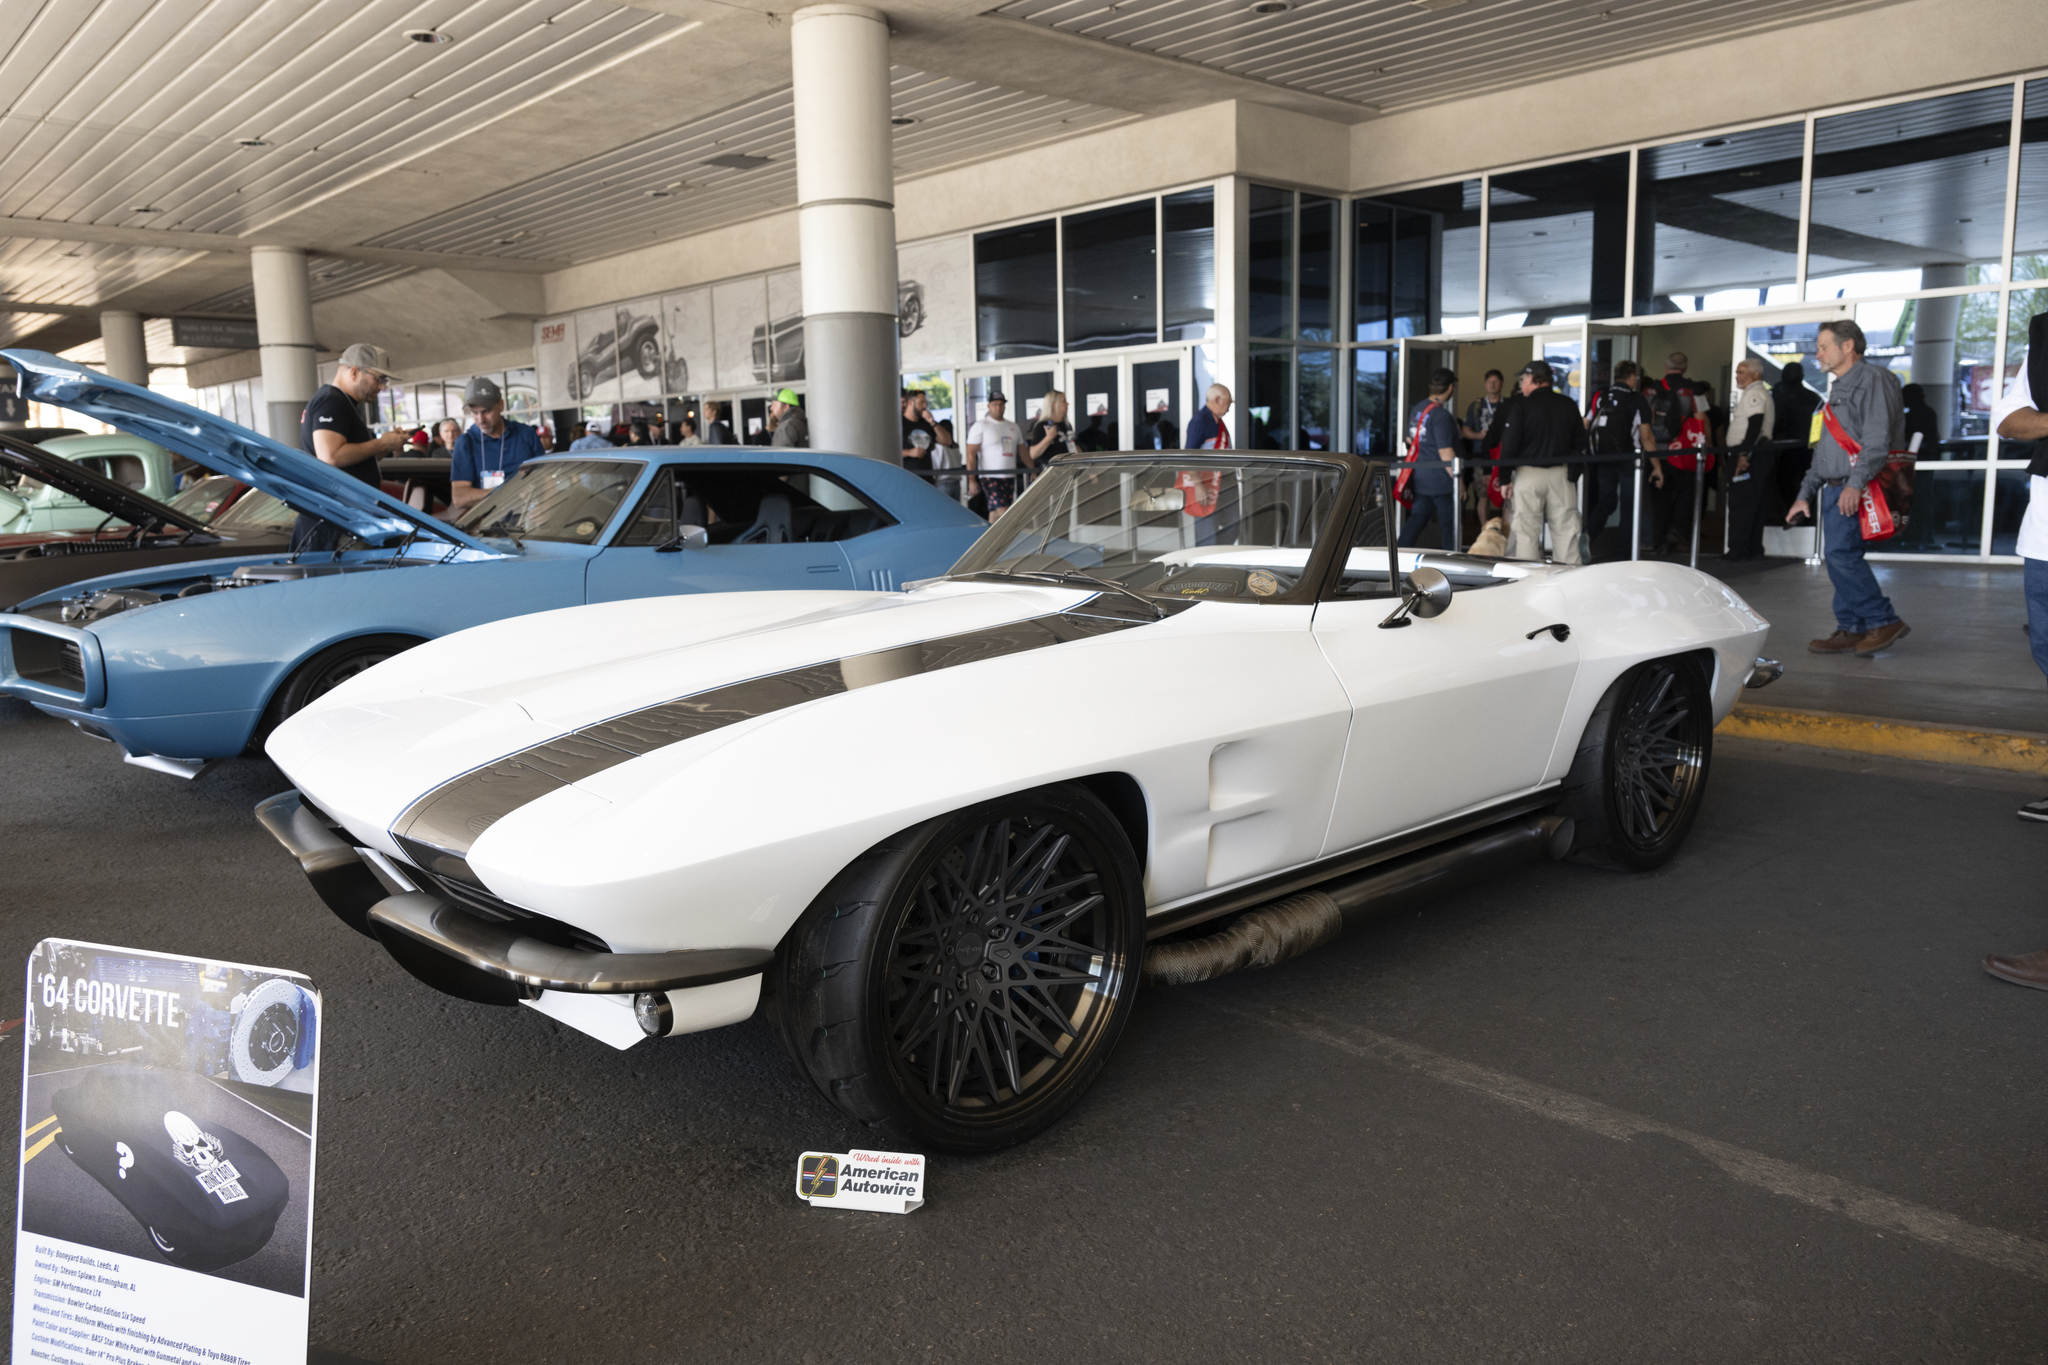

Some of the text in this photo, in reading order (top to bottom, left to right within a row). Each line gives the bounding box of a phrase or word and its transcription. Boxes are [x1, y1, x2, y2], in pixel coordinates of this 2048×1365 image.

[1862, 486, 1881, 534] YDER
[74, 978, 180, 1028] CORVETTE
[853, 1153, 921, 1166] Wired inside with
[200, 1164, 235, 1190] BONEYARD
[840, 1164, 920, 1182] American
[840, 1179, 916, 1196] Autowire
[56, 1250, 79, 1262] Boneyard
[79, 1256, 96, 1268] Builds,
[96, 1260, 112, 1272] Leeds,
[113, 1264, 120, 1272] AL
[34, 1260, 52, 1270] Owned
[60, 1266, 78, 1277] Steven
[97, 1275, 130, 1290] Birmingham,
[130, 1283, 136, 1292] AL
[34, 1274, 52, 1285] Engine:
[60, 1281, 93, 1296] Performance
[92, 1289, 102, 1298] LT4
[66, 1298, 85, 1308] Bowler
[84, 1302, 104, 1313] Carbon
[103, 1306, 121, 1318] Edition
[121, 1311, 130, 1320] Six
[130, 1314, 146, 1324] Speed
[32, 1304, 50, 1314] Wheels
[74, 1314, 96, 1326] Rotiform
[96, 1320, 114, 1332] Wheels
[115, 1326, 127, 1334] with
[127, 1328, 150, 1342] finishing
[150, 1334, 158, 1344] by
[157, 1336, 183, 1350] Advanced
[182, 1342, 202, 1356] Plating
[207, 1349, 220, 1360] Toyo
[31, 1348, 50, 1361] Booster,
[85, 1346, 98, 1357] Baer
[106, 1352, 115, 1362] Pro
[91, 1334, 104, 1343] BASF
[104, 1337, 114, 1346] Star
[114, 1340, 130, 1350] White
[130, 1344, 144, 1354] Pearl
[144, 1348, 156, 1358] with
[156, 1351, 182, 1364] Gunmetal
